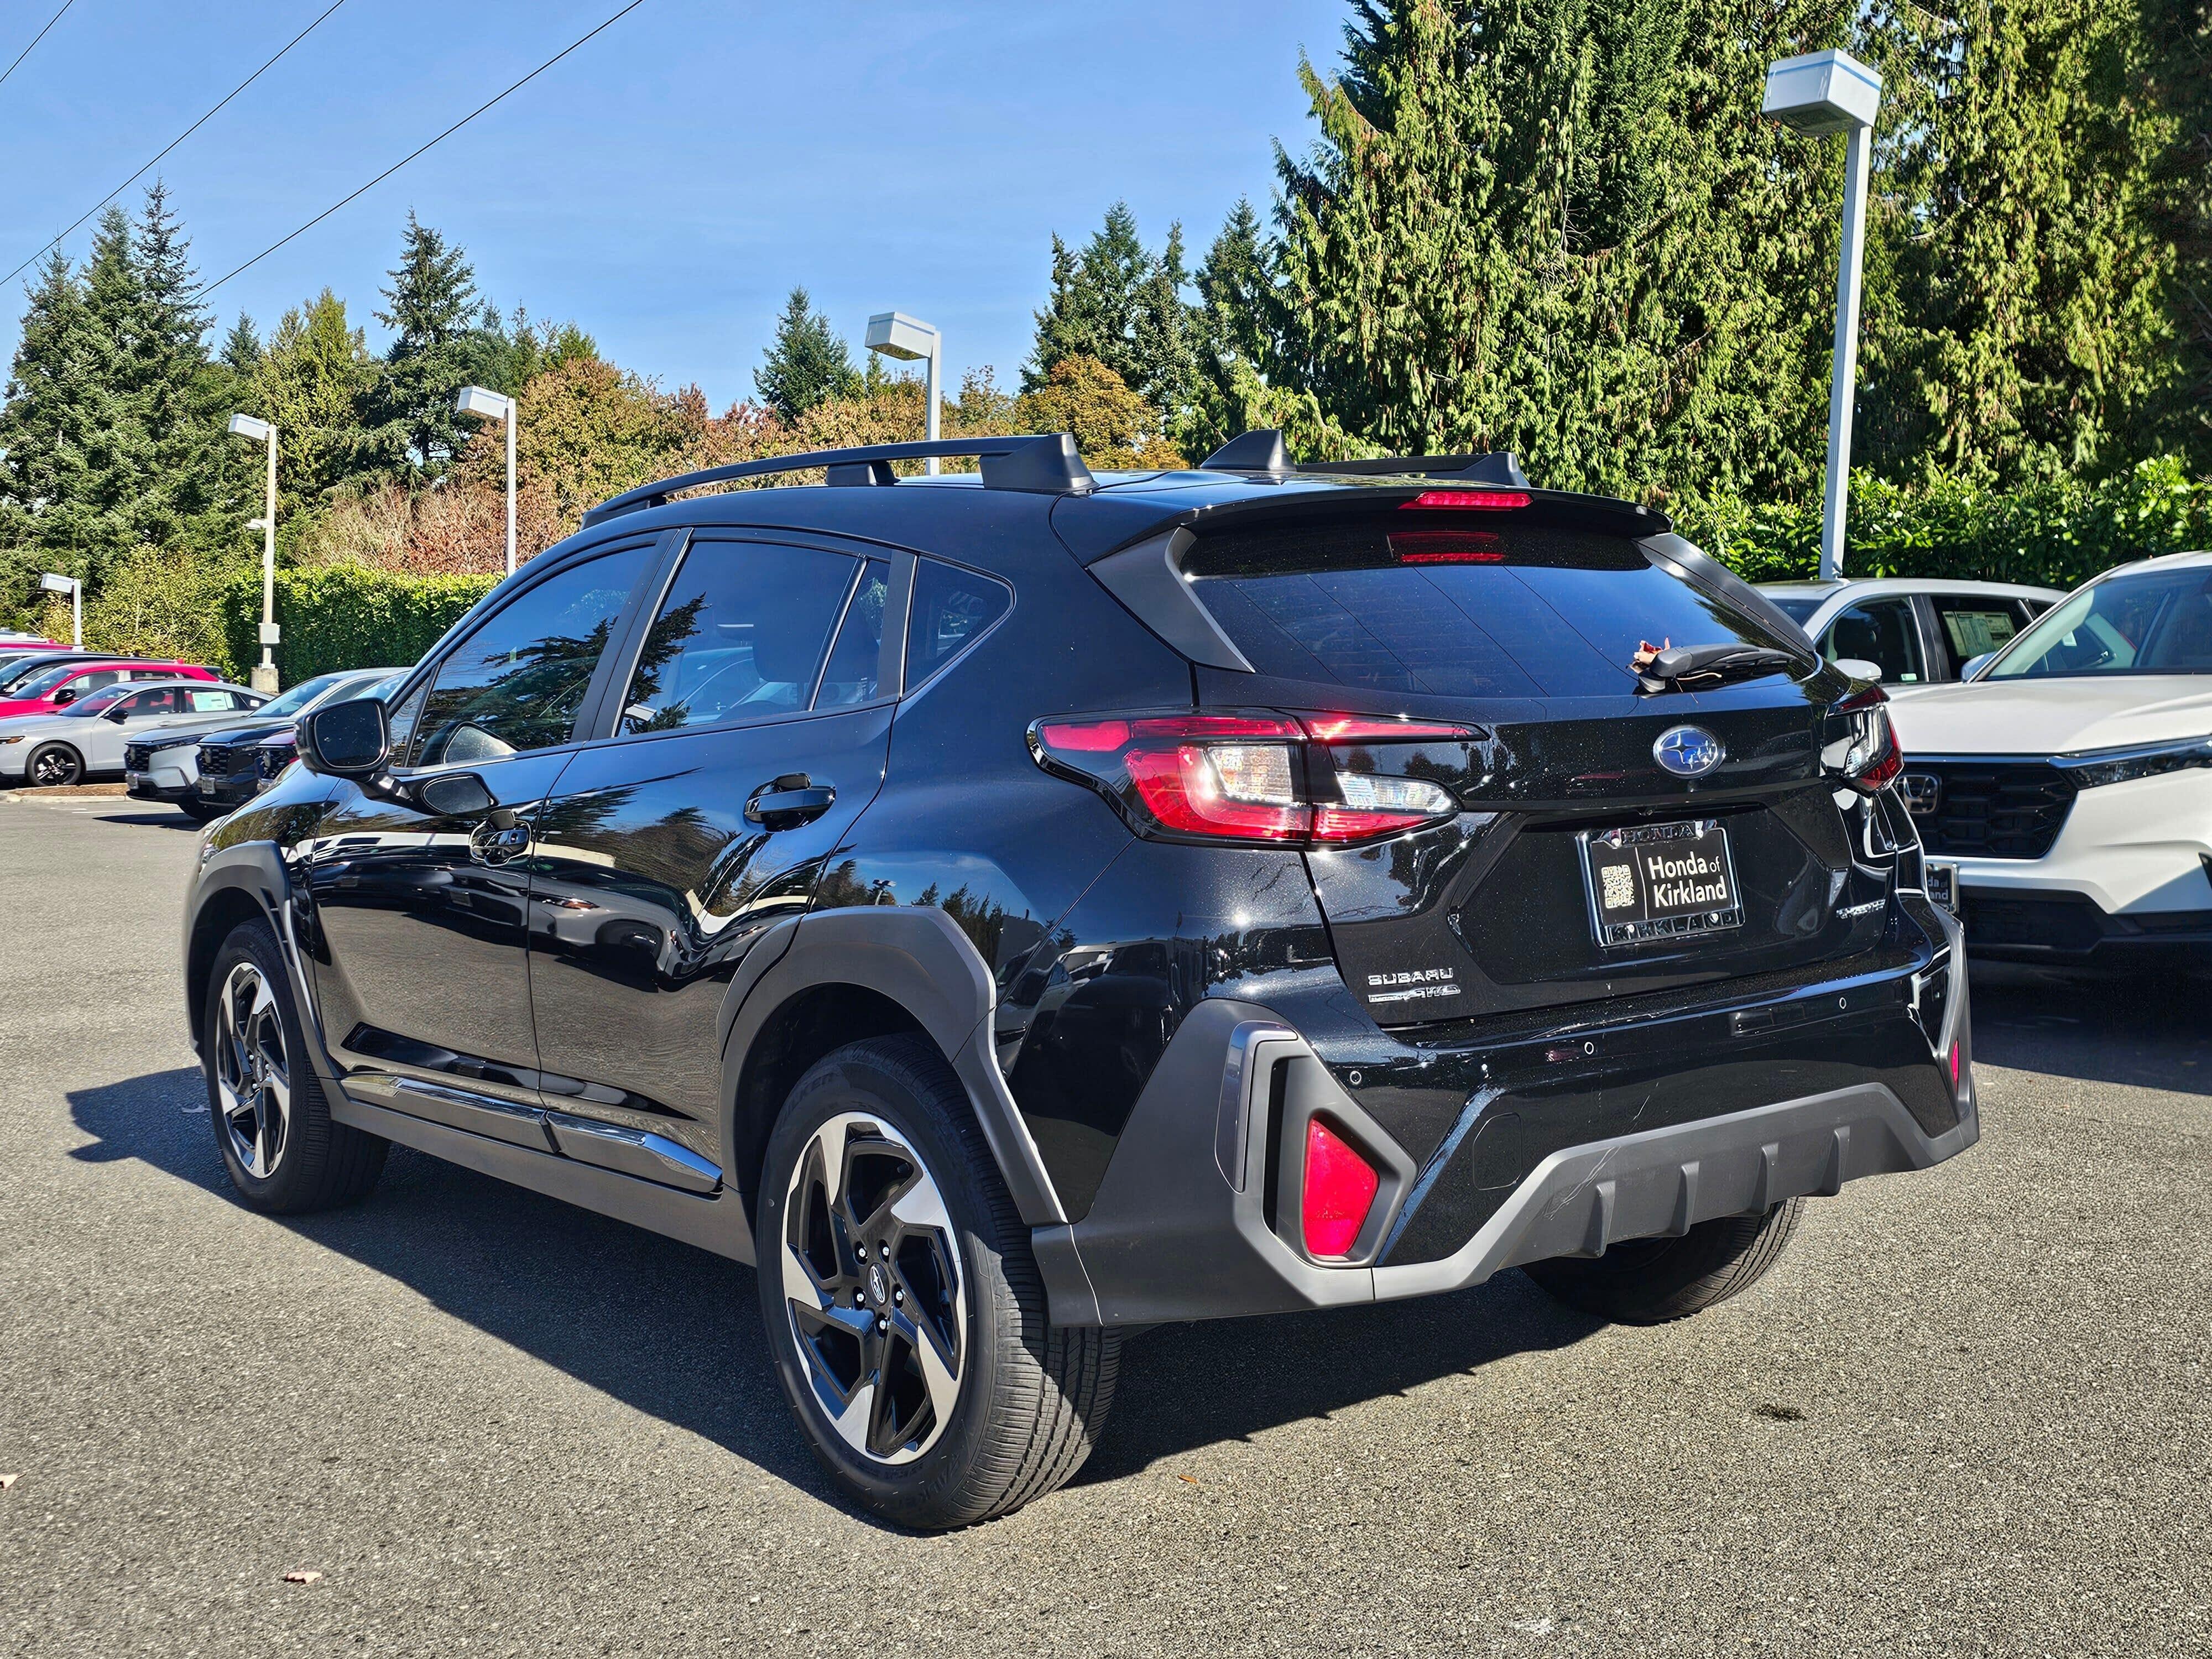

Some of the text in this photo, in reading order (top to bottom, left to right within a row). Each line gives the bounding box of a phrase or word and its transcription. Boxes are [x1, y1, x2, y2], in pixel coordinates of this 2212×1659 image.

[1648, 851, 1720, 879] Honda of
[1653, 876, 1727, 907] Kirkland
[1368, 968, 1453, 985] SUBARU
